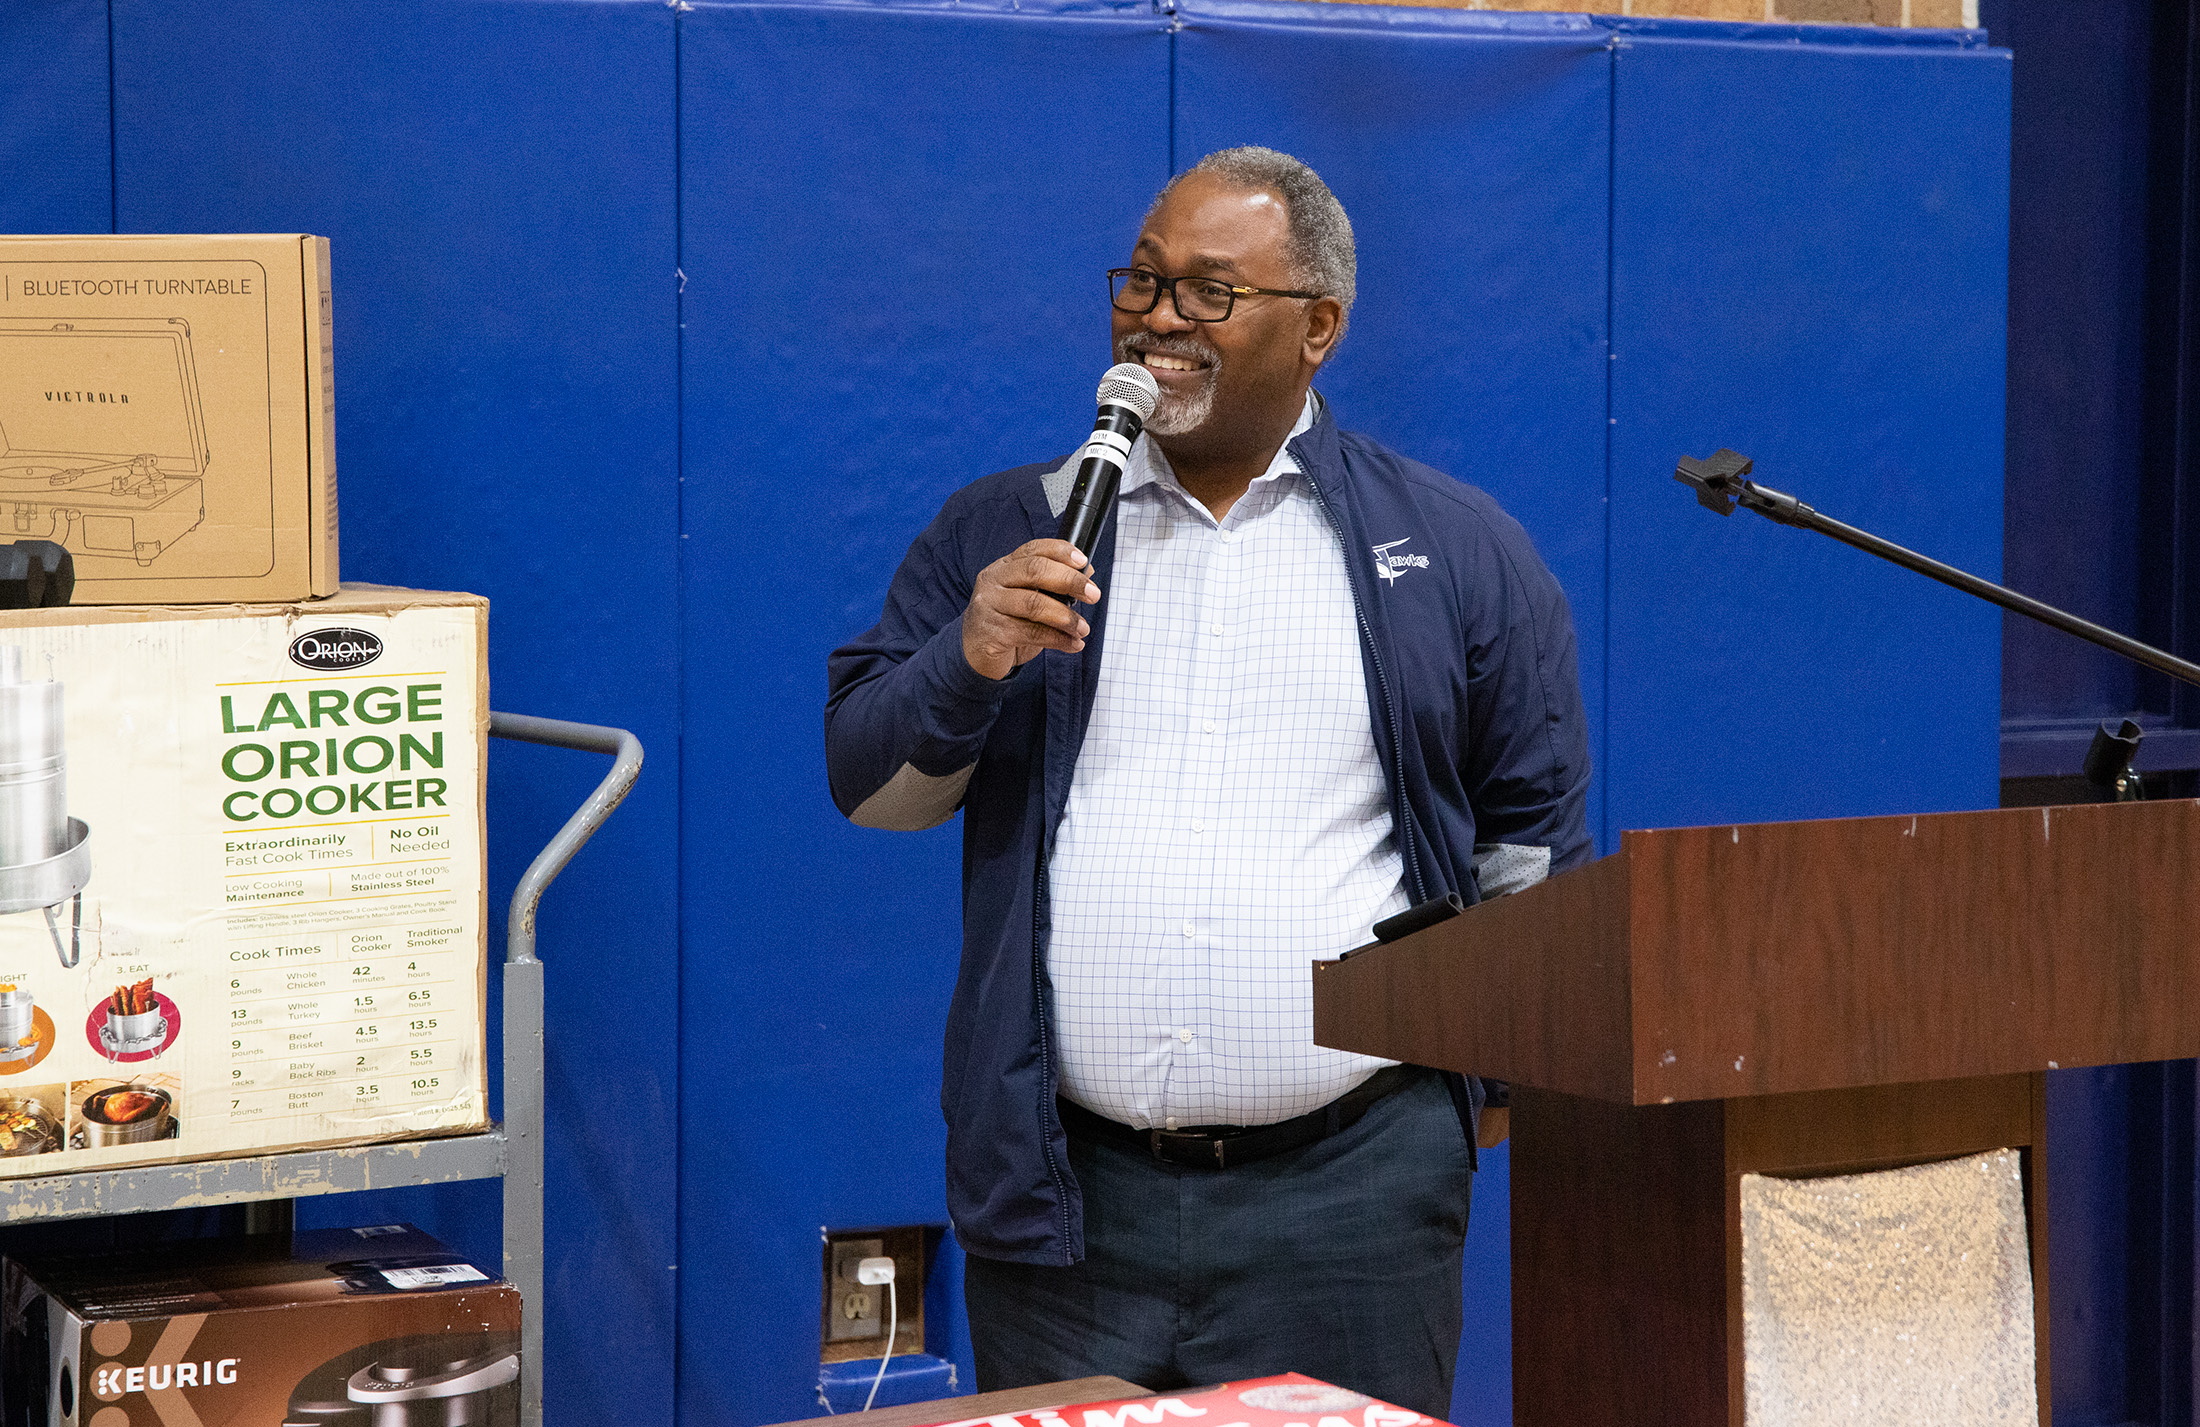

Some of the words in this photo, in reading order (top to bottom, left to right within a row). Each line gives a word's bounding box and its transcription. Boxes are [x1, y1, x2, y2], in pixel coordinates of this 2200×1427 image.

[23, 279, 138, 296] BLUETOOTH
[143, 278, 252, 295] TURNTABLE
[45, 391, 129, 404] VICTROLA
[1103, 449, 1108, 457] 2
[298, 637, 367, 660] ORION
[220, 683, 442, 734] LARGE
[221, 731, 443, 782] ORION
[222, 777, 447, 822] COOKER
[390, 828, 412, 839] No
[416, 826, 439, 838] Oil
[225, 834, 347, 853] Extraordinarily
[390, 839, 450, 854] Needed
[225, 854, 258, 867] Fast
[262, 851, 304, 864] Cook
[308, 848, 354, 861] Times
[351, 871, 382, 882] Made
[386, 870, 405, 879] out
[407, 868, 417, 877] of
[421, 866, 450, 876] 100%
[225, 882, 250, 893] Low
[253, 878, 303, 891] Cooking
[351, 880, 402, 892] Stainless
[405, 877, 435, 888] Steel
[226, 888, 305, 903] Maintenance
[407, 926, 463, 938] Traditional
[351, 934, 383, 943] Orion
[407, 938, 449, 948] Smoker
[351, 942, 393, 953] Cooker
[229, 948, 271, 962] Cook
[275, 944, 322, 958] Times
[129, 964, 150, 973] EAT
[352, 966, 371, 976] 42
[407, 962, 417, 971] 4
[286, 970, 318, 980] Whole
[407, 969, 431, 978] hours
[230, 979, 240, 988] 6
[352, 975, 386, 984] minutes
[286, 980, 326, 990] Chicken
[230, 987, 263, 997] pounds
[408, 990, 431, 1001] 6.5
[288, 1001, 319, 1010] Whole
[354, 996, 374, 1006] 1.5
[408, 1000, 432, 1008] hours
[231, 1009, 247, 1019] 13
[354, 1005, 378, 1014] hours
[288, 1010, 321, 1021] Turkey
[231, 1017, 264, 1028] pounds
[409, 1018, 438, 1030] 13.5
[355, 1025, 378, 1036] 4.5
[409, 1029, 433, 1038] hours
[288, 1032, 313, 1042] Beef
[355, 1035, 379, 1044] hours
[231, 1040, 241, 1050] 9
[288, 1040, 324, 1050] Brisket
[231, 1048, 264, 1058] pounds
[410, 1048, 433, 1059] 5.5
[356, 1056, 366, 1066] 2
[410, 1058, 434, 1067] hours
[289, 1061, 316, 1072] Baby
[356, 1064, 379, 1074] hours
[232, 1069, 242, 1079] 9
[289, 1070, 314, 1080] Back
[316, 1068, 338, 1078] Ribs
[231, 1078, 256, 1087] racks
[410, 1077, 440, 1090] 10.5
[356, 1084, 379, 1096] 3.5
[410, 1088, 435, 1097] hours
[288, 1090, 325, 1101] Boston
[356, 1094, 380, 1104] hours
[231, 1100, 240, 1110] 7
[288, 1100, 309, 1110] Butt
[230, 1106, 264, 1117] pounds
[98, 1358, 237, 1396] KEURIG
